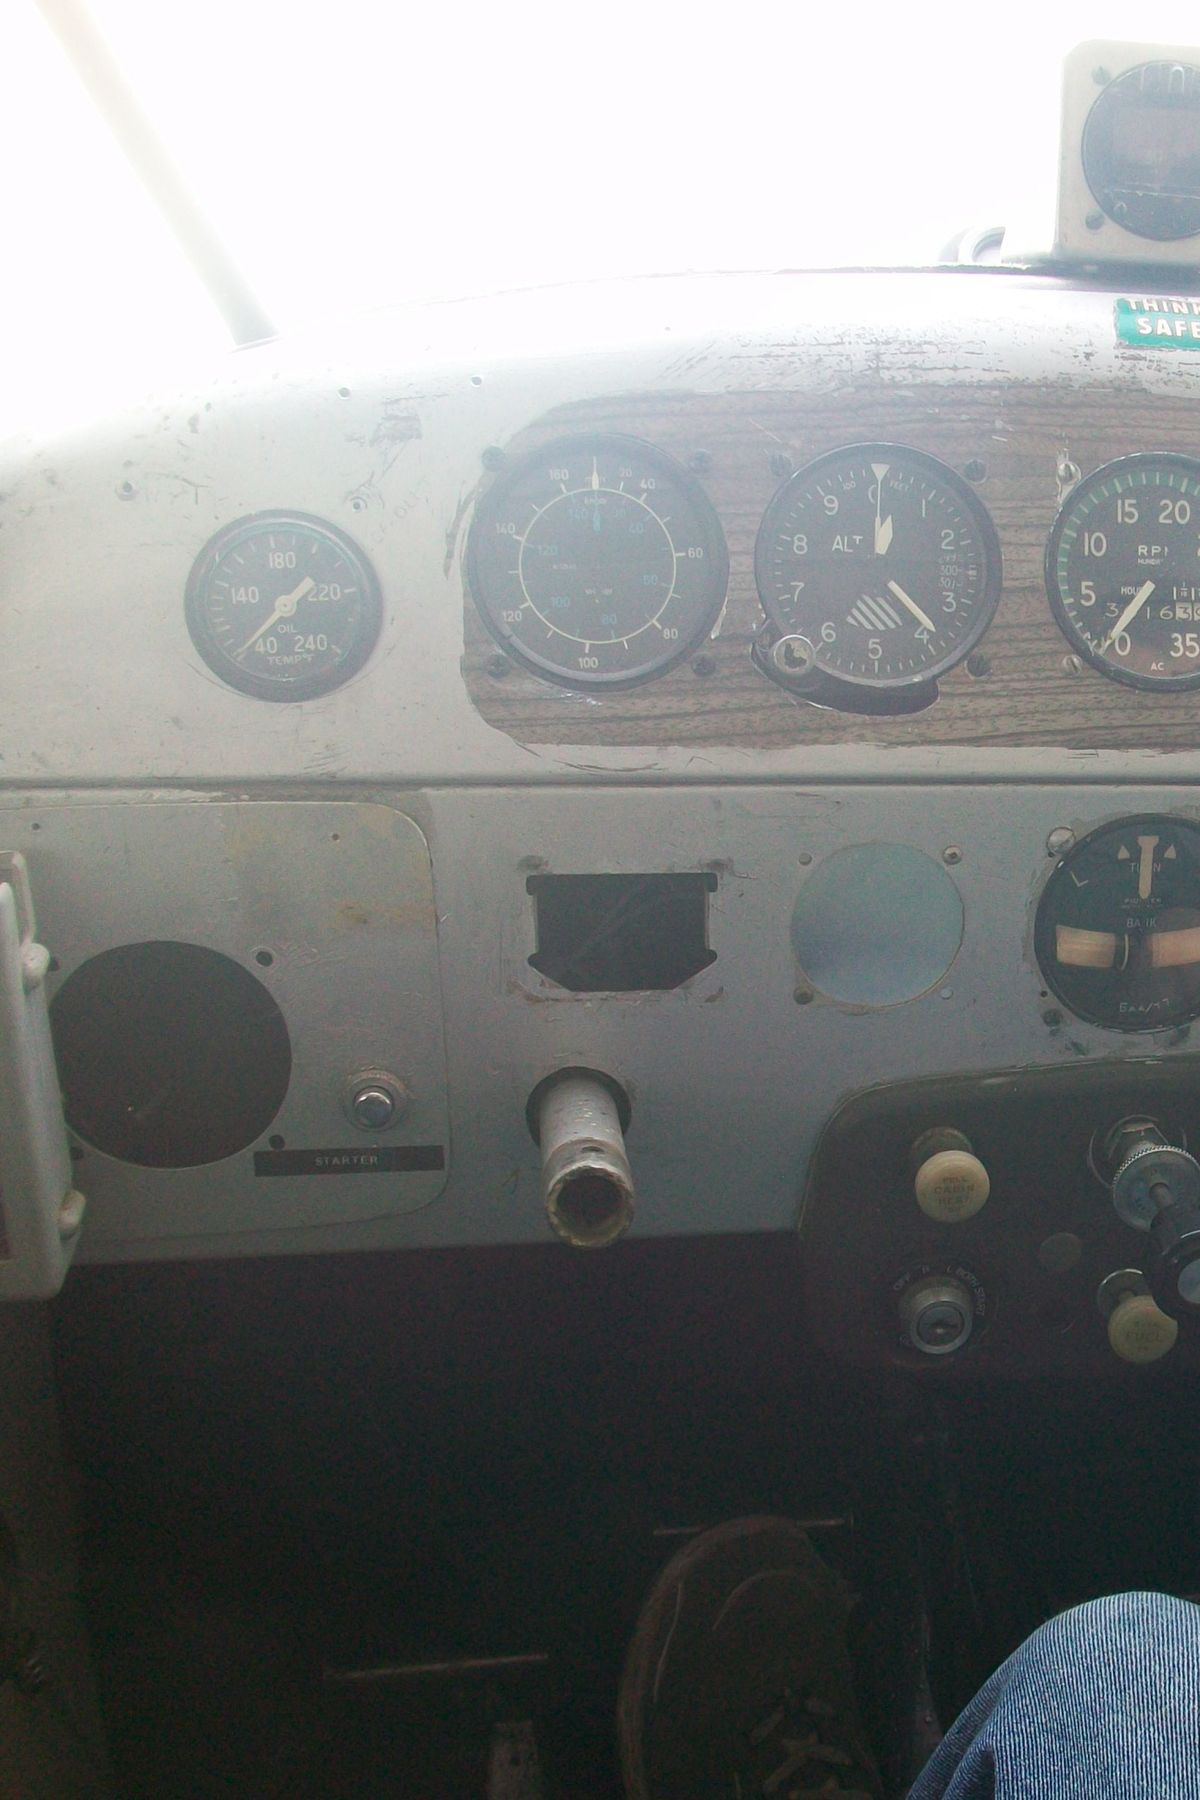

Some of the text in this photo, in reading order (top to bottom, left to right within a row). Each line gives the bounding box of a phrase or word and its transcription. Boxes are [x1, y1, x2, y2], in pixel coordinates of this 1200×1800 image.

[549, 470, 569, 481] 160
[640, 478, 656, 489] 40
[823, 495, 839, 515] 9
[921, 498, 926, 518] 1
[1117, 499, 1140, 524] 15
[1158, 500, 1191, 524] 20
[496, 523, 516, 535] 140
[793, 534, 809, 555] 8
[832, 535, 863, 553] ALT
[941, 529, 955, 550] 2
[1084, 532, 1107, 557] 10
[269, 551, 296, 569] 180
[688, 547, 704, 559] 60
[231, 586, 260, 604] 140
[307, 583, 341, 601] 220
[790, 581, 805, 602] 7
[1080, 581, 1097, 607] 5
[942, 592, 957, 612] 3
[503, 610, 523, 622] 120
[277, 624, 297, 634] OIL
[663, 628, 679, 640] 80
[820, 622, 836, 643] 6
[913, 624, 931, 645] 4
[255, 636, 278, 654] 40
[294, 634, 328, 652] 240
[867, 639, 883, 659] 5
[1114, 631, 1132, 656] 0
[1170, 633, 1200, 658] 35
[578, 657, 600, 669] 100
[1150, 661, 1165, 671] AC
[1129, 862, 1161, 873] TN
[1071, 872, 1089, 887] L
[314, 1156, 379, 1167] STARTER
